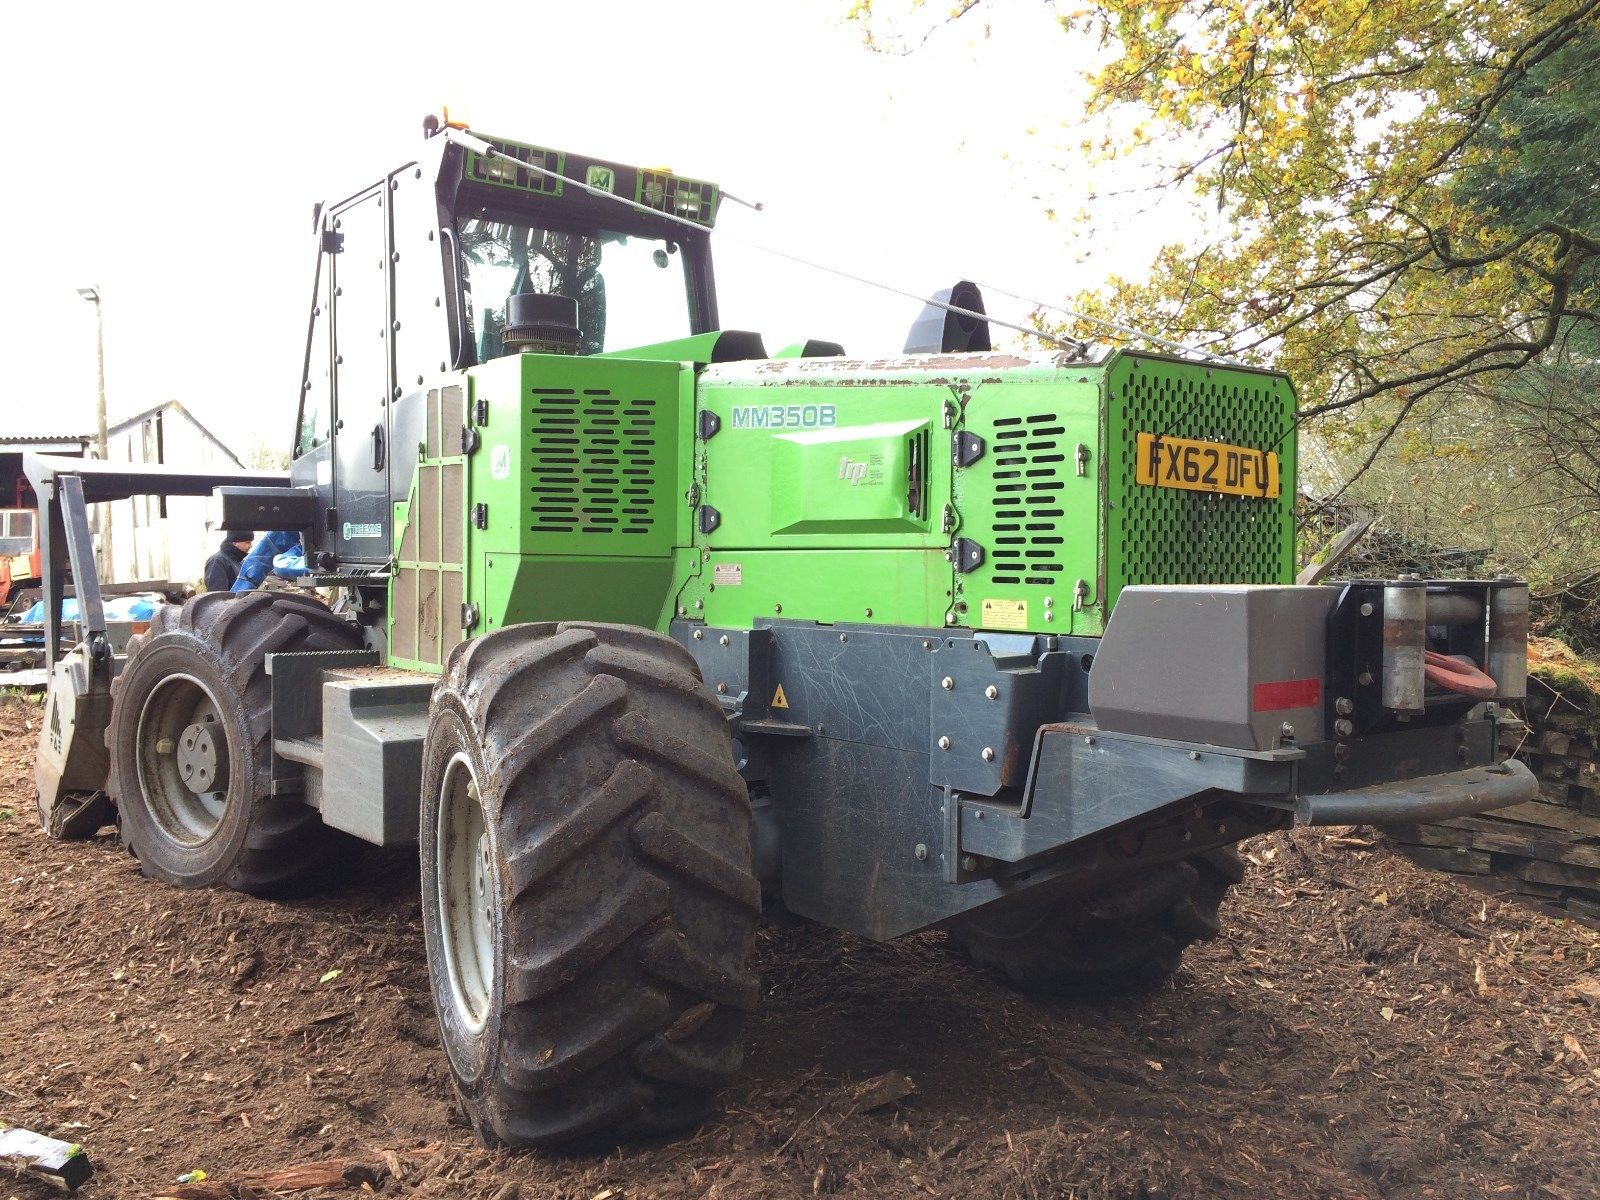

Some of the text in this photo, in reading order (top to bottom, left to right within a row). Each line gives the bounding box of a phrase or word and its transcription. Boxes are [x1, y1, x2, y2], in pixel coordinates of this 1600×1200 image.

[732, 404, 836, 428] MM350B
[1148, 441, 1269, 490] FX62 DFU
